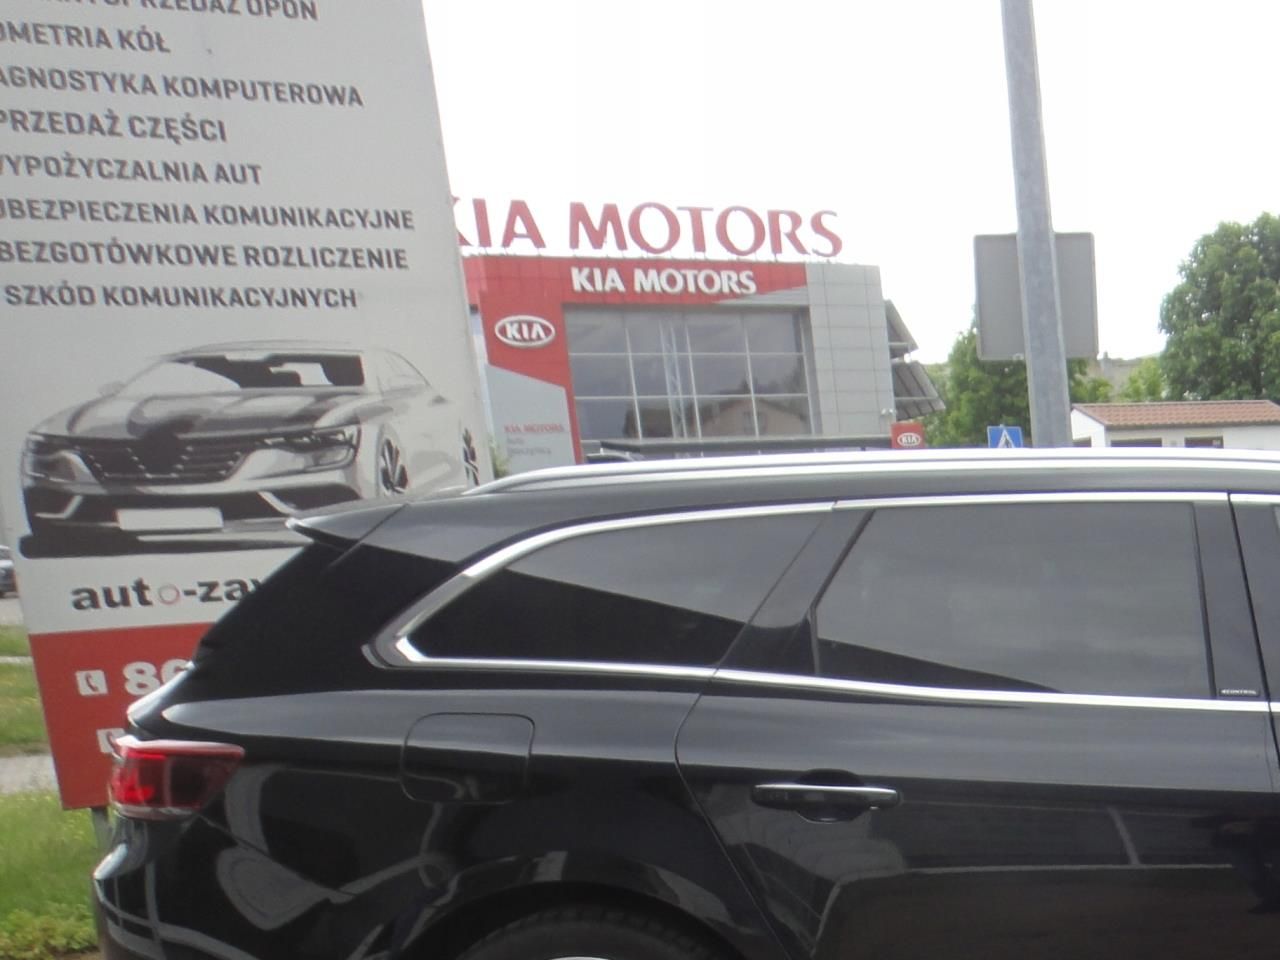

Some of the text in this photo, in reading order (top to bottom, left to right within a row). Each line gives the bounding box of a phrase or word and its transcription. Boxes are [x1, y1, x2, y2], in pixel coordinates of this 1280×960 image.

[117, 25, 170, 53] KÓŁ
[162, 75, 365, 107] KOMPUTEROWA
[128, 112, 227, 145] CZĘŚCI
[0, 151, 261, 185] YPOŻYCZALNIA AUT
[204, 205, 415, 230] KOMUNIKACYJNE
[569, 202, 844, 257] MOTORS
[0, 236, 408, 269] BEZGOTÓWKOWE ROZLICZENIE
[4, 279, 357, 309] SZKÓD KOMUNIKACYJNYCH
[571, 266, 757, 295] KIA MOTORS
[505, 322, 546, 340] KIA
